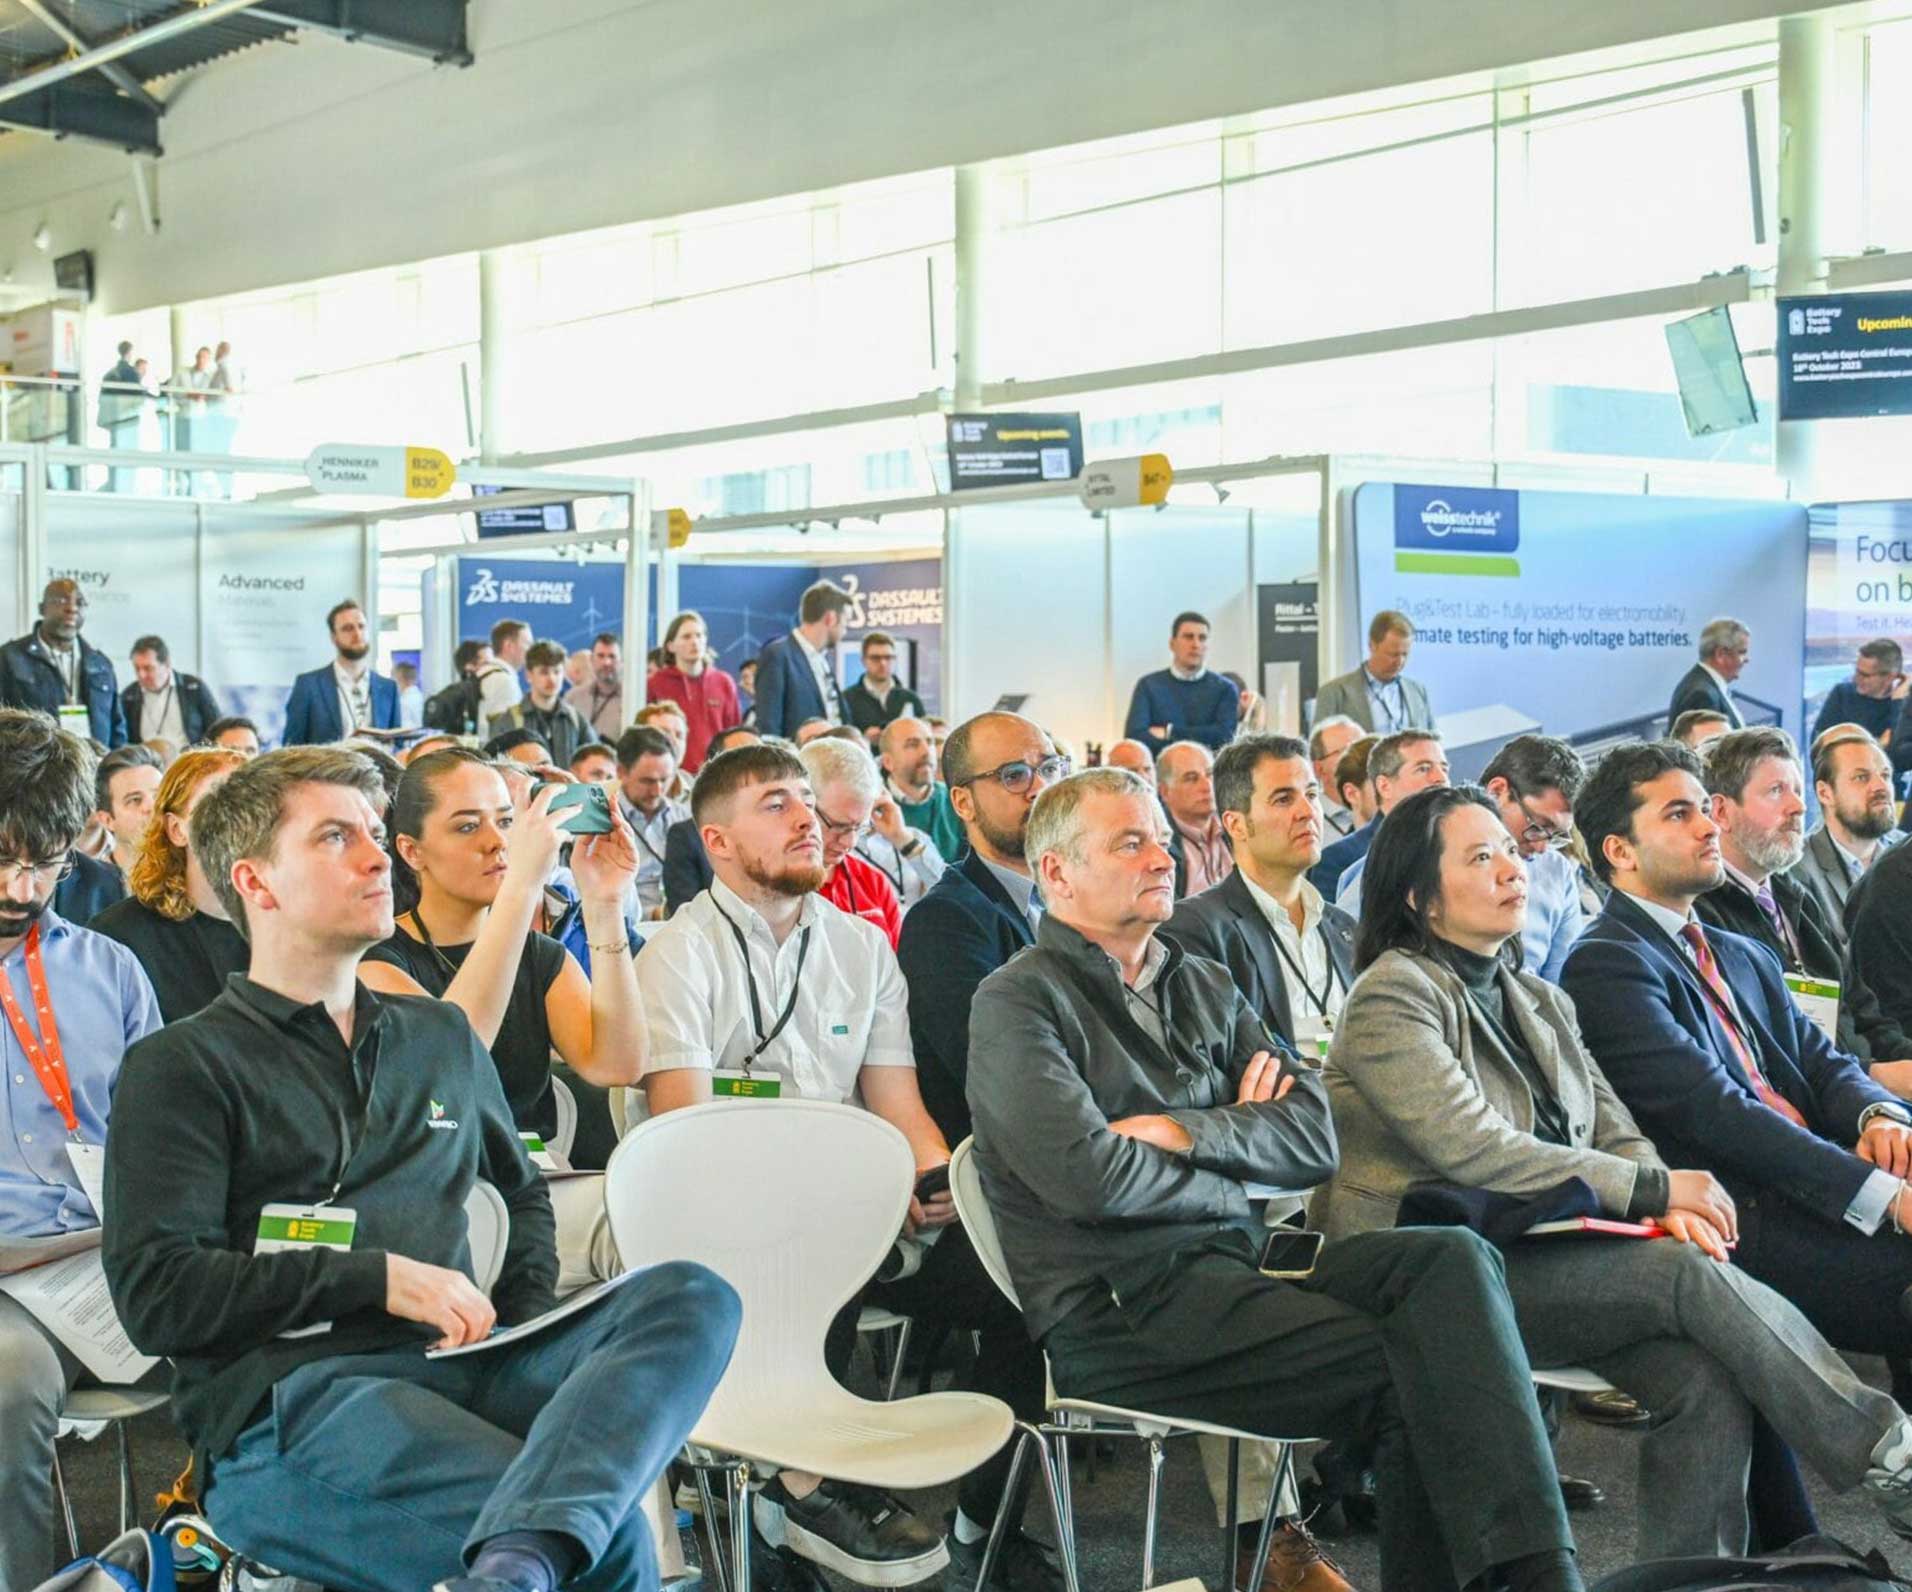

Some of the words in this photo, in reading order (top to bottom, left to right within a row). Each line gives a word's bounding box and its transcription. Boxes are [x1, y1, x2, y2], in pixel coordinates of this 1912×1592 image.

[321, 471, 368, 481] PLASMA
[218, 573, 305, 591] Advanced
[1856, 582, 1890, 603] on
[1415, 627, 1453, 644] mate
[1457, 627, 1509, 650] testing
[1513, 627, 1534, 645] for
[1537, 627, 1625, 650] high-voltage
[1628, 628, 1693, 647] batteries.
